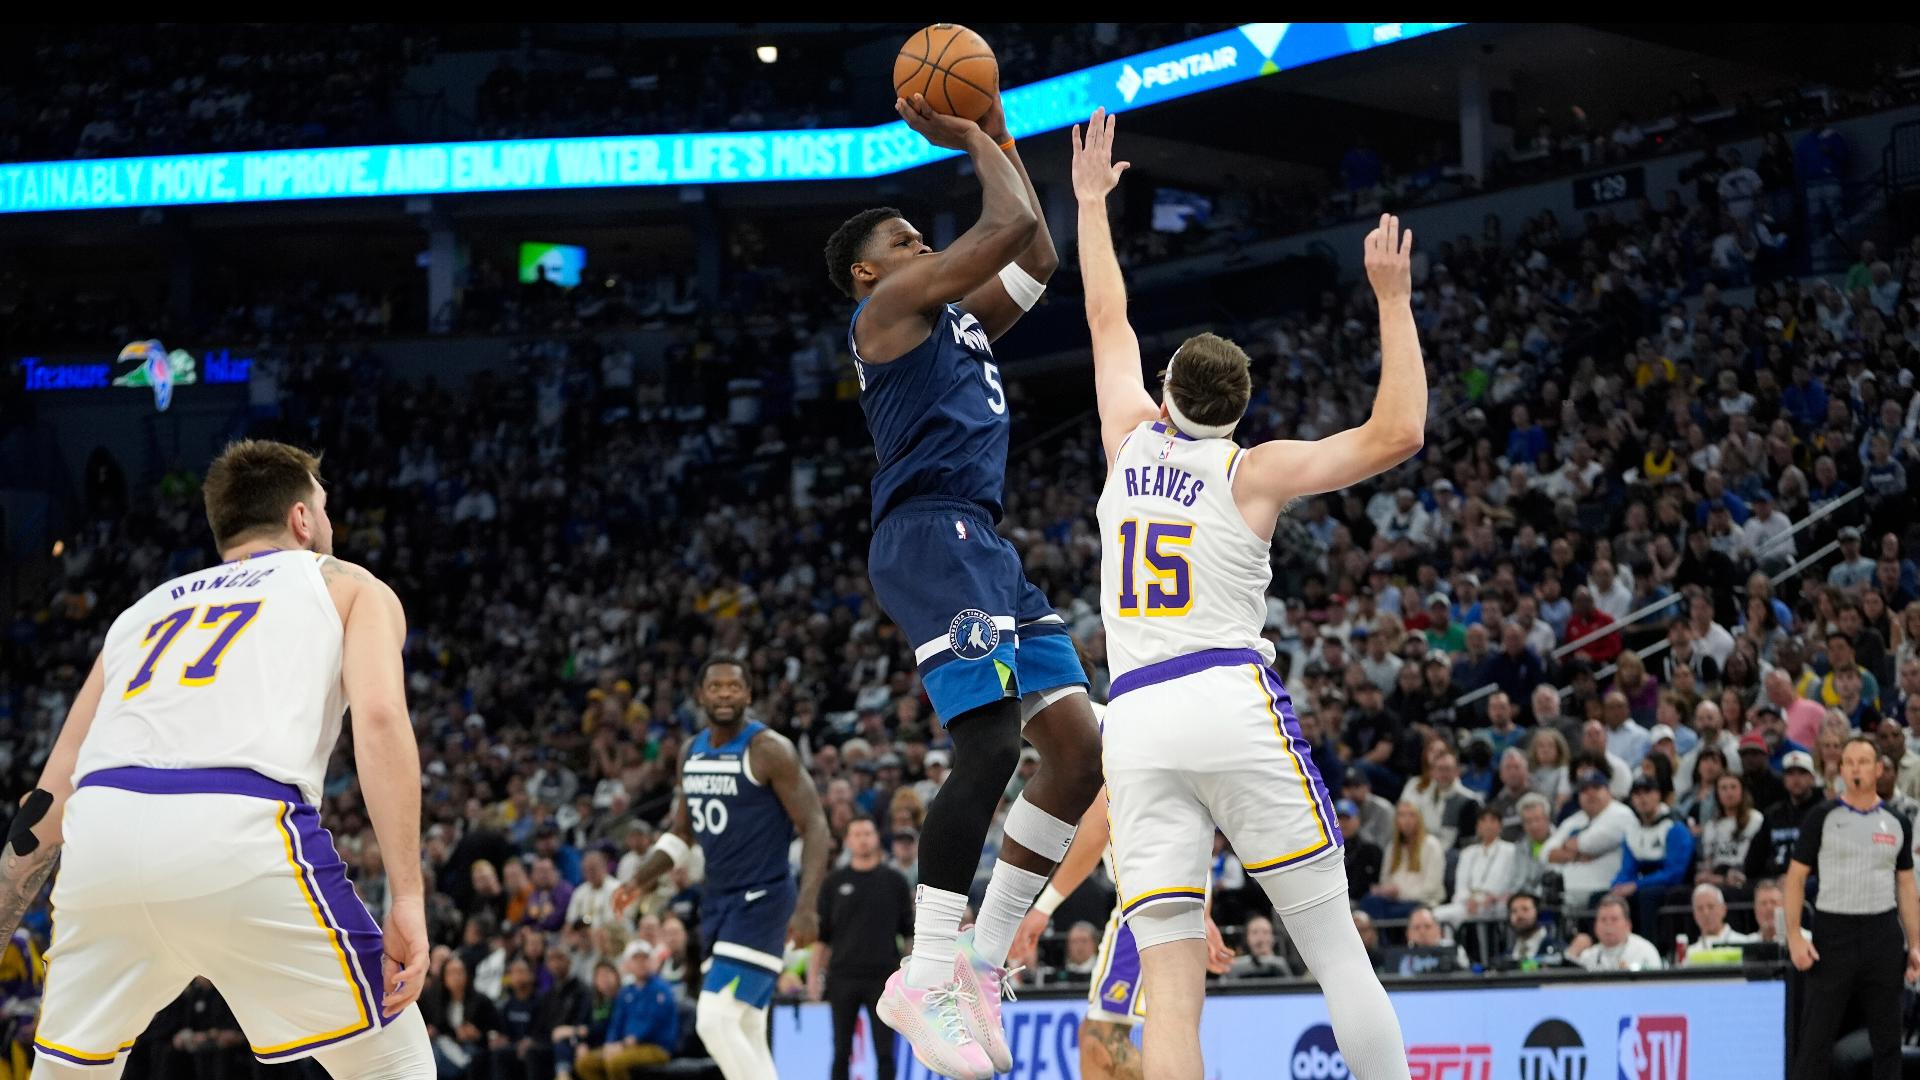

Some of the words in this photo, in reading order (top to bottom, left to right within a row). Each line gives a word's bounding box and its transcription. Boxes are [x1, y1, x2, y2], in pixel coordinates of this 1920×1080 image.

[1142, 46, 1238, 88] PENTAIR
[0, 163, 144, 209] TAINABLY
[383, 147, 448, 191] AND
[451, 143, 550, 188] ENJOY
[673, 135, 766, 180] LIFE'S
[772, 132, 853, 178] MOST
[983, 361, 1006, 415] 5
[1125, 465, 1204, 507] REAVES
[1118, 518, 1197, 617] 15
[122, 598, 266, 701] 77
[682, 775, 739, 796] MINNESOTA
[687, 798, 728, 834] 30
[1293, 1045, 1348, 1080] abc
[1646, 1031, 1683, 1080] TV
